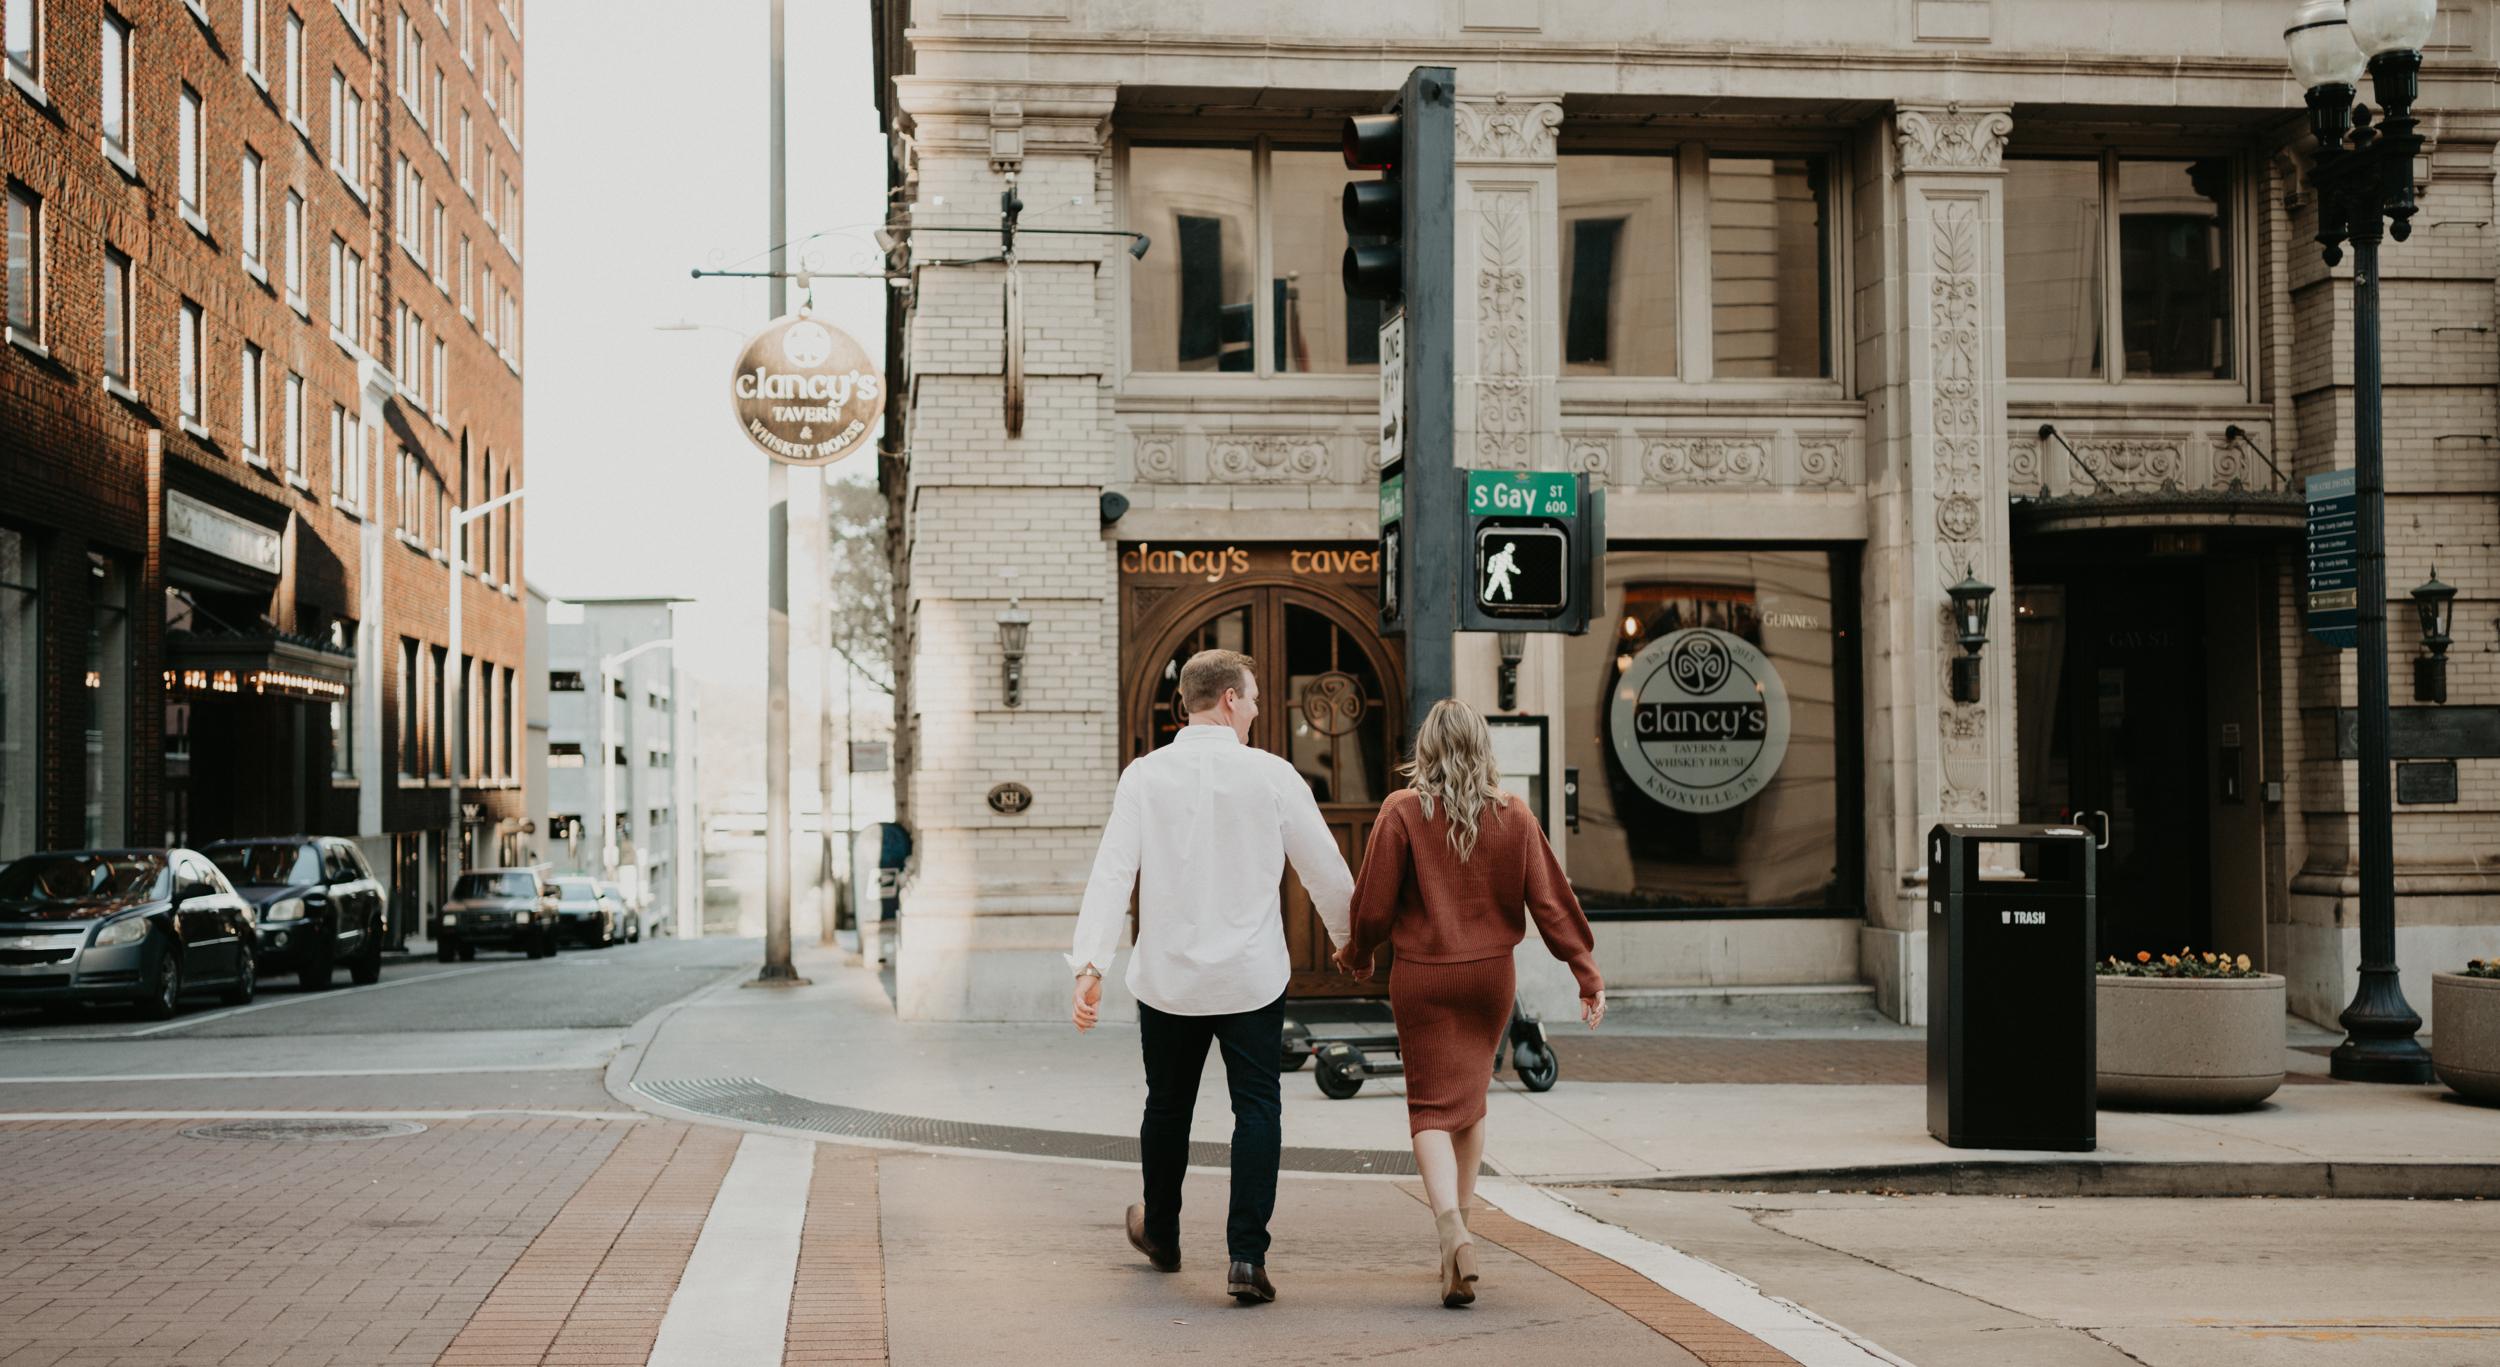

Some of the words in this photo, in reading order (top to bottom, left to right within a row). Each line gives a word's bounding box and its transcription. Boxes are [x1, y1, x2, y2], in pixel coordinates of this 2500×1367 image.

[1385, 329, 1399, 365] ONE
[735, 366, 879, 407] clancy's
[772, 406, 841, 422] TAVERN
[749, 418, 814, 458] WHISKEY
[816, 418, 865, 457] HOUSE
[799, 425, 813, 440] &
[1474, 484, 1488, 508] S
[1493, 483, 1537, 516] Gay
[1550, 485, 1564, 498] ST
[1545, 501, 1567, 513] 600
[1121, 542, 1250, 582] clancy's
[1291, 549, 1380, 574] taver
[1763, 611, 1818, 628] GUINNESS
[1636, 703, 1765, 740] clancy's
[1673, 743, 1716, 754] TAVERN
[1719, 744, 1728, 753] &
[1655, 757, 1705, 768] WHISKEY
[1709, 757, 1746, 768] HOUSE
[1000, 791, 1020, 805] KH
[1646, 775, 1738, 806] KNOXVILLE,
[1739, 773, 1759, 792] TN
[2013, 911, 2046, 924] TRASH
